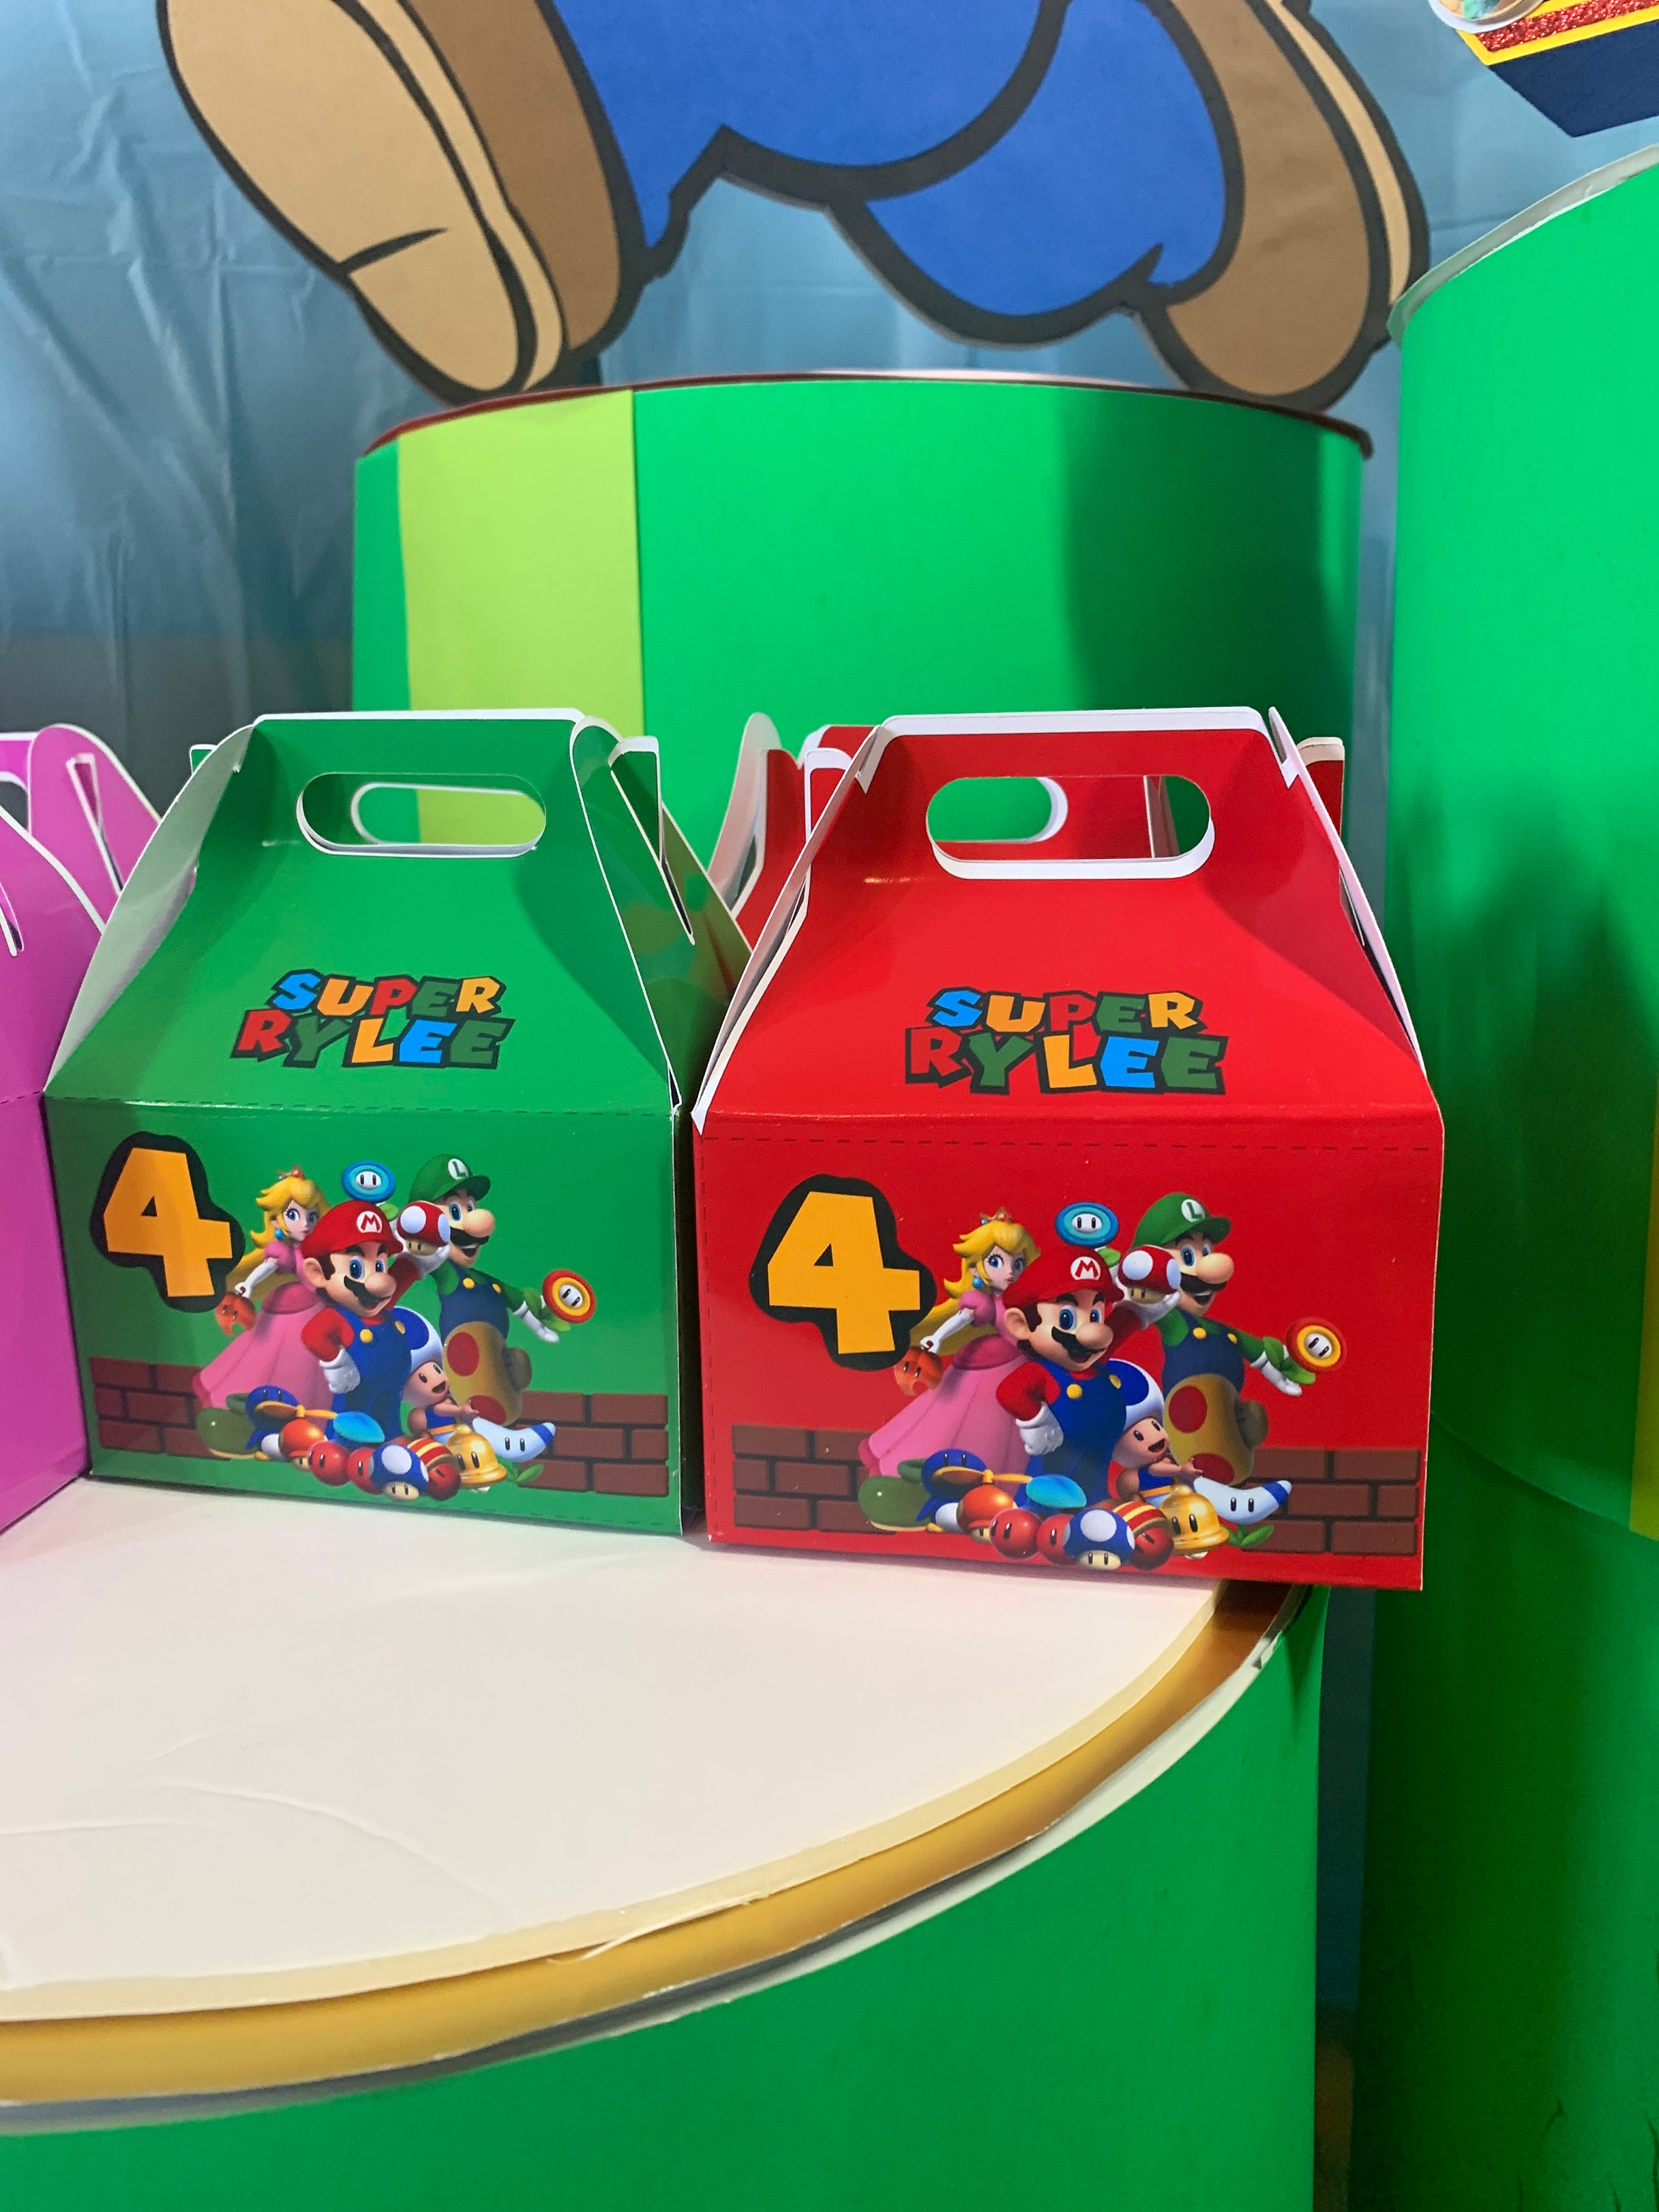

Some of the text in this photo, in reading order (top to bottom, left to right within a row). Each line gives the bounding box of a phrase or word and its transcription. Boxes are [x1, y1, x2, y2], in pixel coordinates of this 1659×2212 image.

[268, 969, 507, 1019] SUPER
[925, 987, 1207, 1033] SUPER
[230, 1009, 516, 1069] RYLEE
[905, 1026, 1229, 1095] RYLEE
[451, 1161, 467, 1178] L
[103, 1147, 232, 1297] 4
[360, 1214, 381, 1231] M
[1186, 1201, 1203, 1220] L
[768, 1191, 920, 1355] 4
[1074, 1259, 1099, 1279] M
